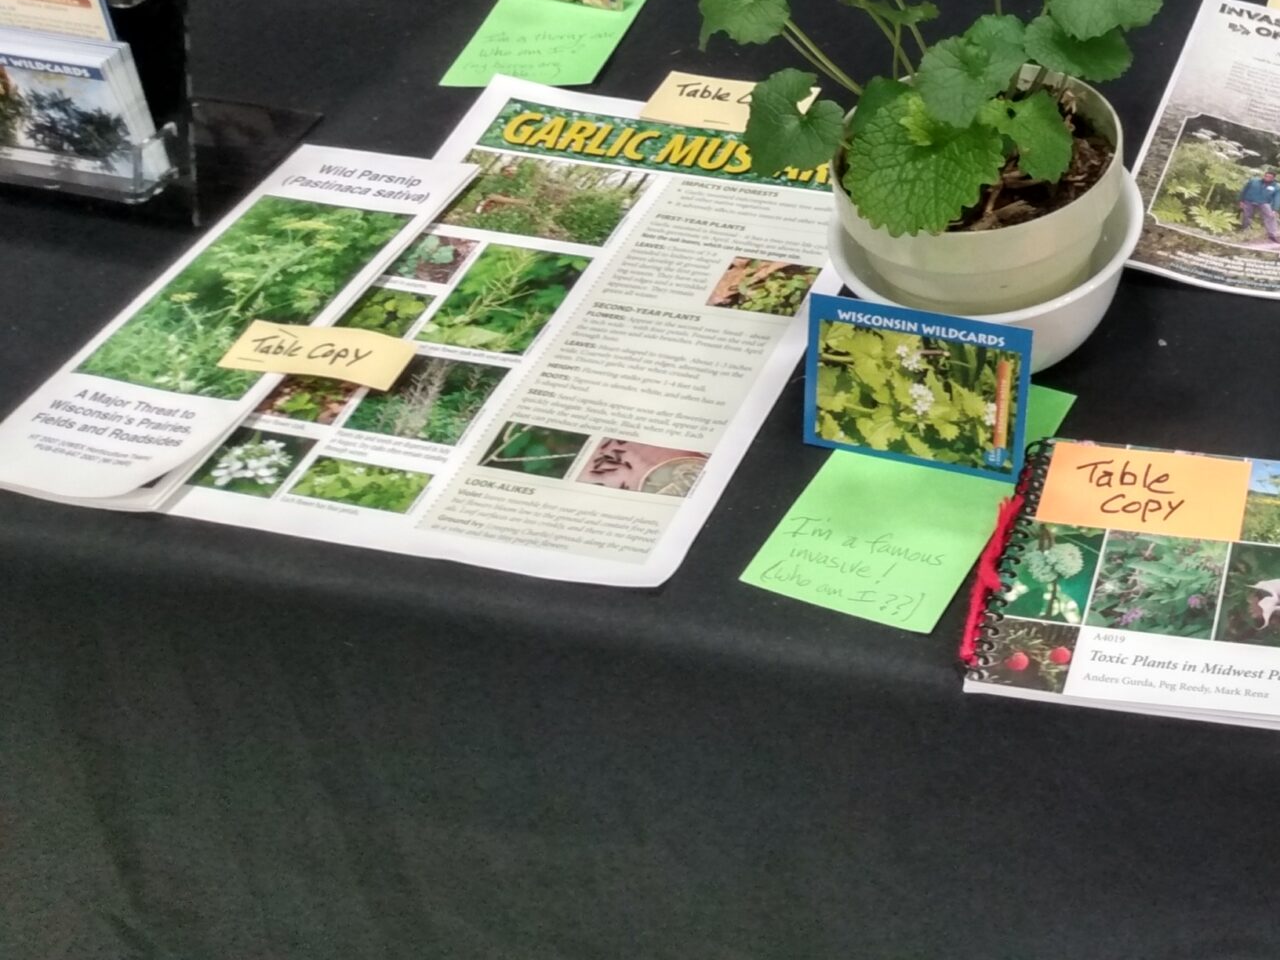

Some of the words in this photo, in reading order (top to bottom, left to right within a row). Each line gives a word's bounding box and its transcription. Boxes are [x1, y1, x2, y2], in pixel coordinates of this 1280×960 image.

[677, 83, 730, 104] Table
[503, 112, 659, 162] GARLIC
[281, 174, 372, 196] (Pastinaca
[376, 187, 430, 205] sativa)
[318, 163, 356, 180] Wild
[358, 168, 423, 189] Parsnip
[837, 309, 918, 333] WISCONSIN
[921, 324, 1005, 347] WILDCARDS
[251, 336, 303, 357] Table
[308, 343, 372, 366] Copy
[1077, 460, 1175, 494] Table
[1089, 649, 1129, 665] Toxic
[1133, 654, 1180, 673] Plants
[1184, 661, 1198, 673] in
[1200, 661, 1265, 680] Midwest
